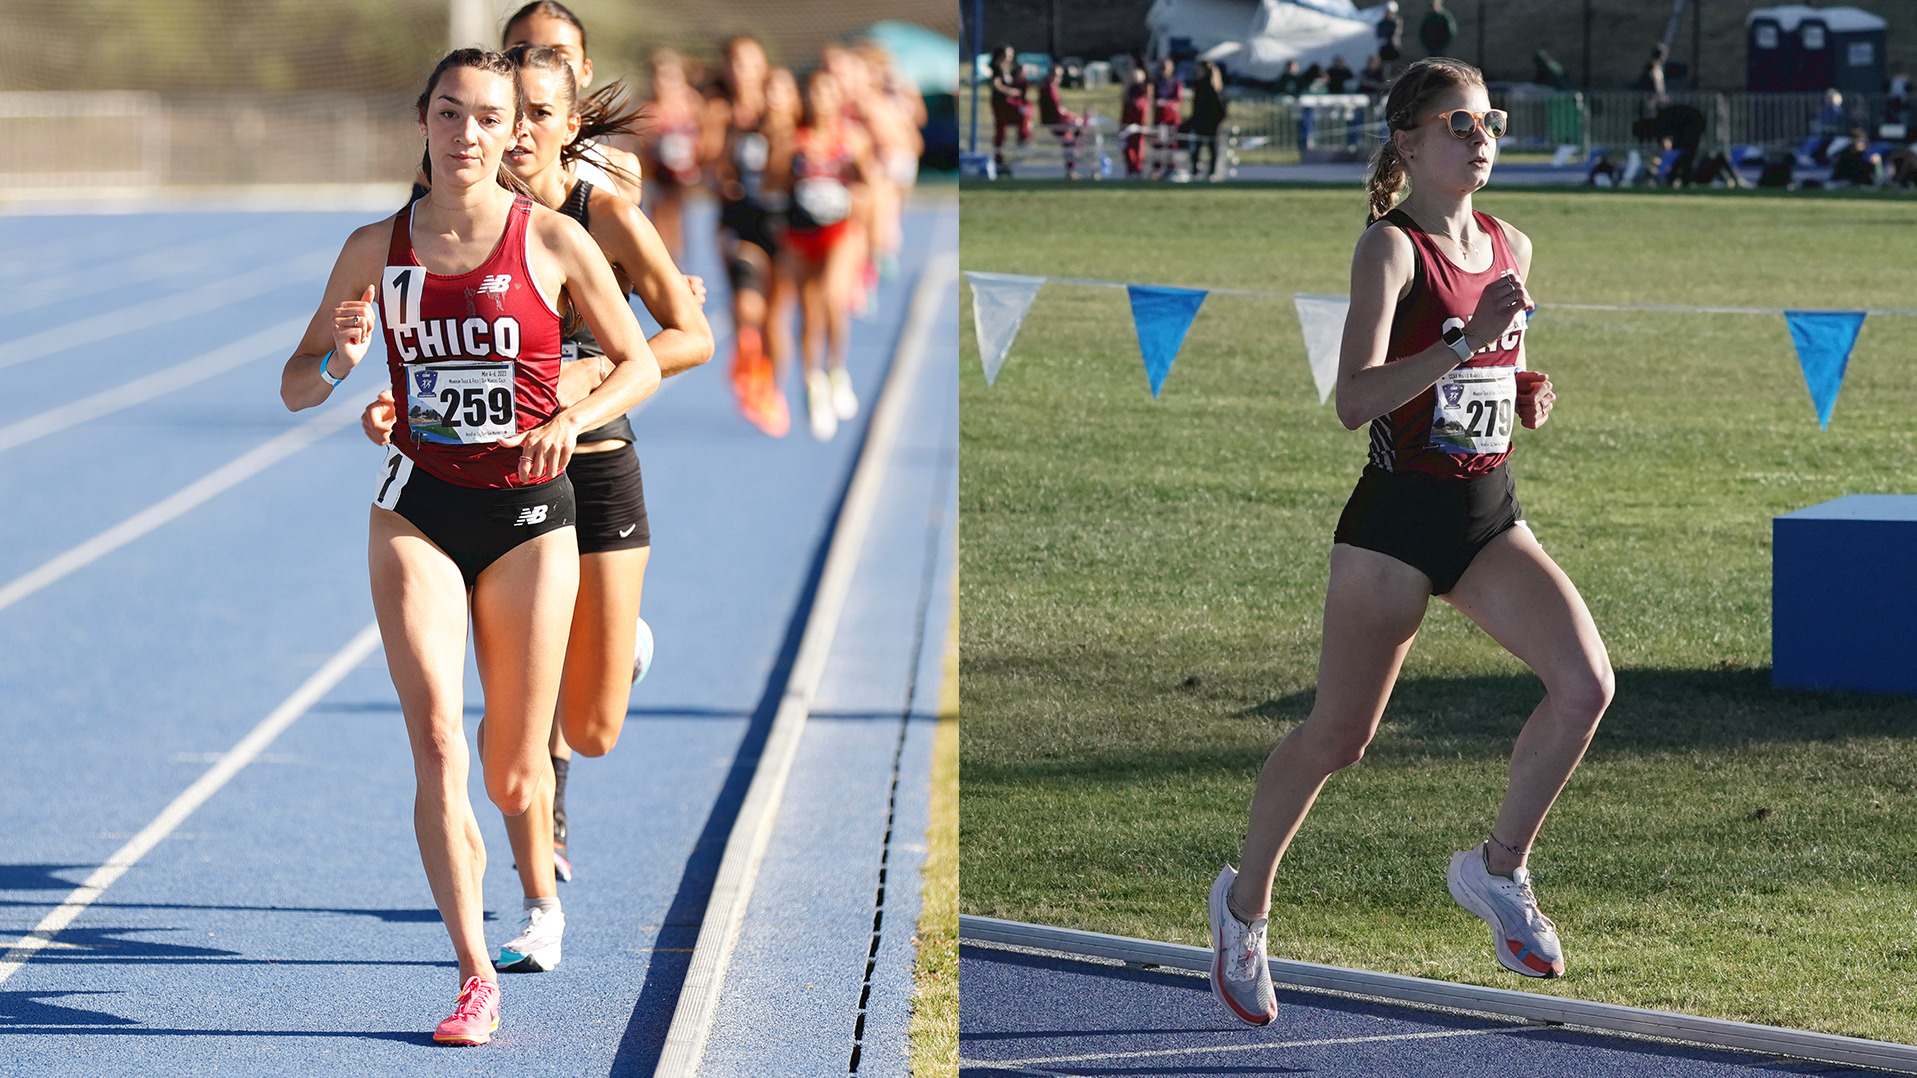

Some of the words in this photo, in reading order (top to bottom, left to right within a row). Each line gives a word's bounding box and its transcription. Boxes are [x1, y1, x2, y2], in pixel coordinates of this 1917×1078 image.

[392, 269, 412, 325] 1
[393, 316, 520, 362] CHICO
[440, 387, 512, 427] 259
[1465, 398, 1511, 437] 279
[376, 453, 402, 503] 1
